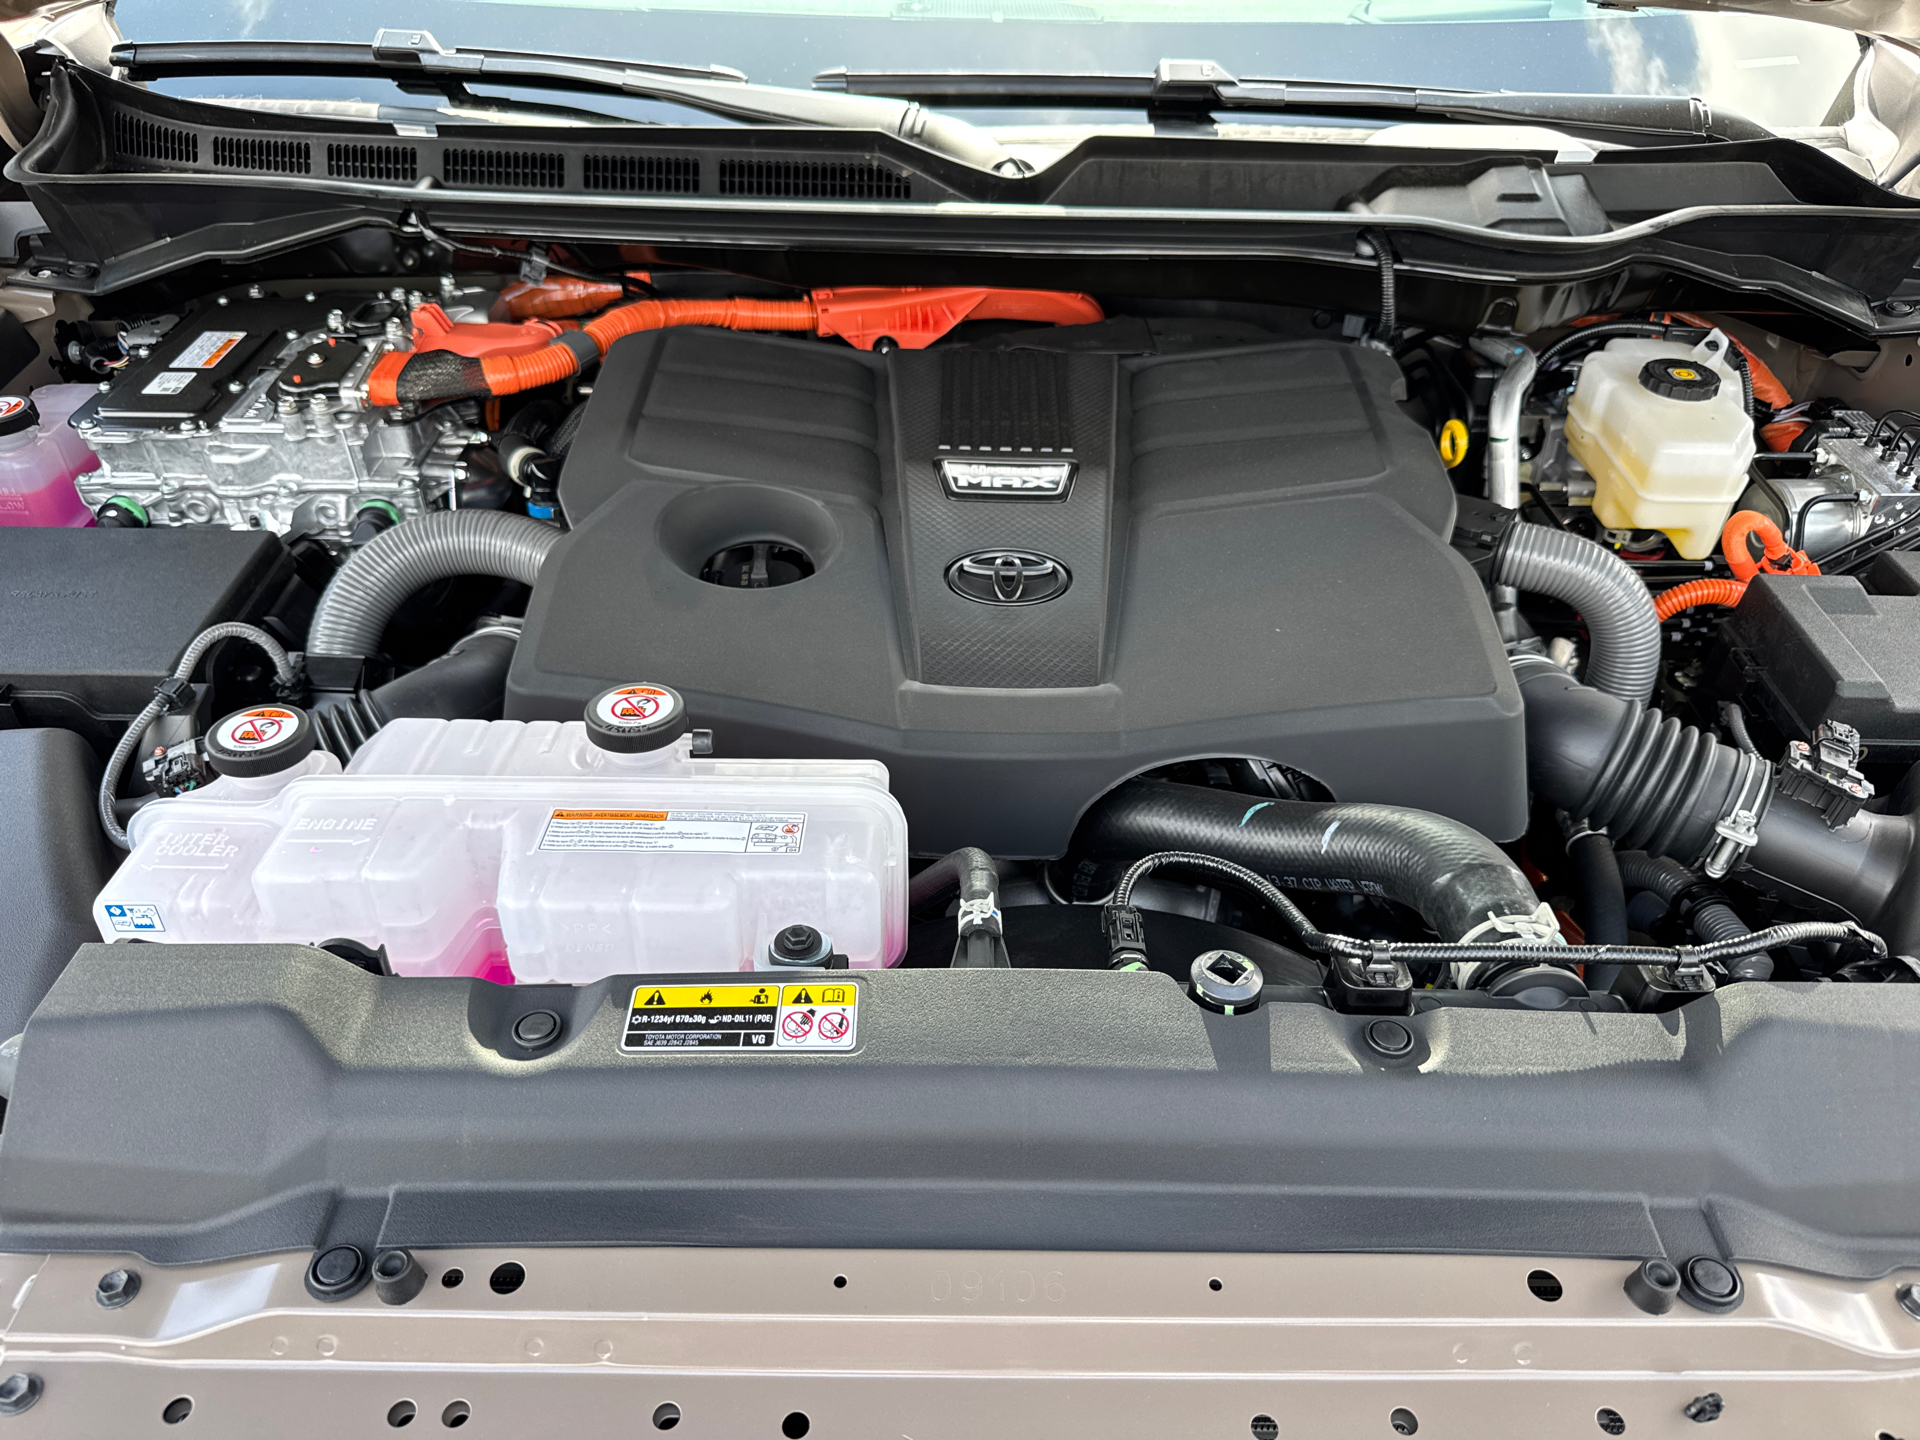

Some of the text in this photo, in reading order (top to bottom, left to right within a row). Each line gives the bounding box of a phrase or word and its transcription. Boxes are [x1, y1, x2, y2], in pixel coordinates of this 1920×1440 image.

[951, 474, 1058, 488] MAX
[294, 817, 378, 831] ENGINE
[160, 832, 230, 845] INTER
[154, 844, 239, 857] COOLER
[641, 1014, 675, 1024] R-1234yf
[675, 1014, 707, 1025] 670±30g
[754, 1013, 774, 1025] (POE)
[751, 1034, 766, 1045] VG
[931, 1269, 1066, 1303] 09106
